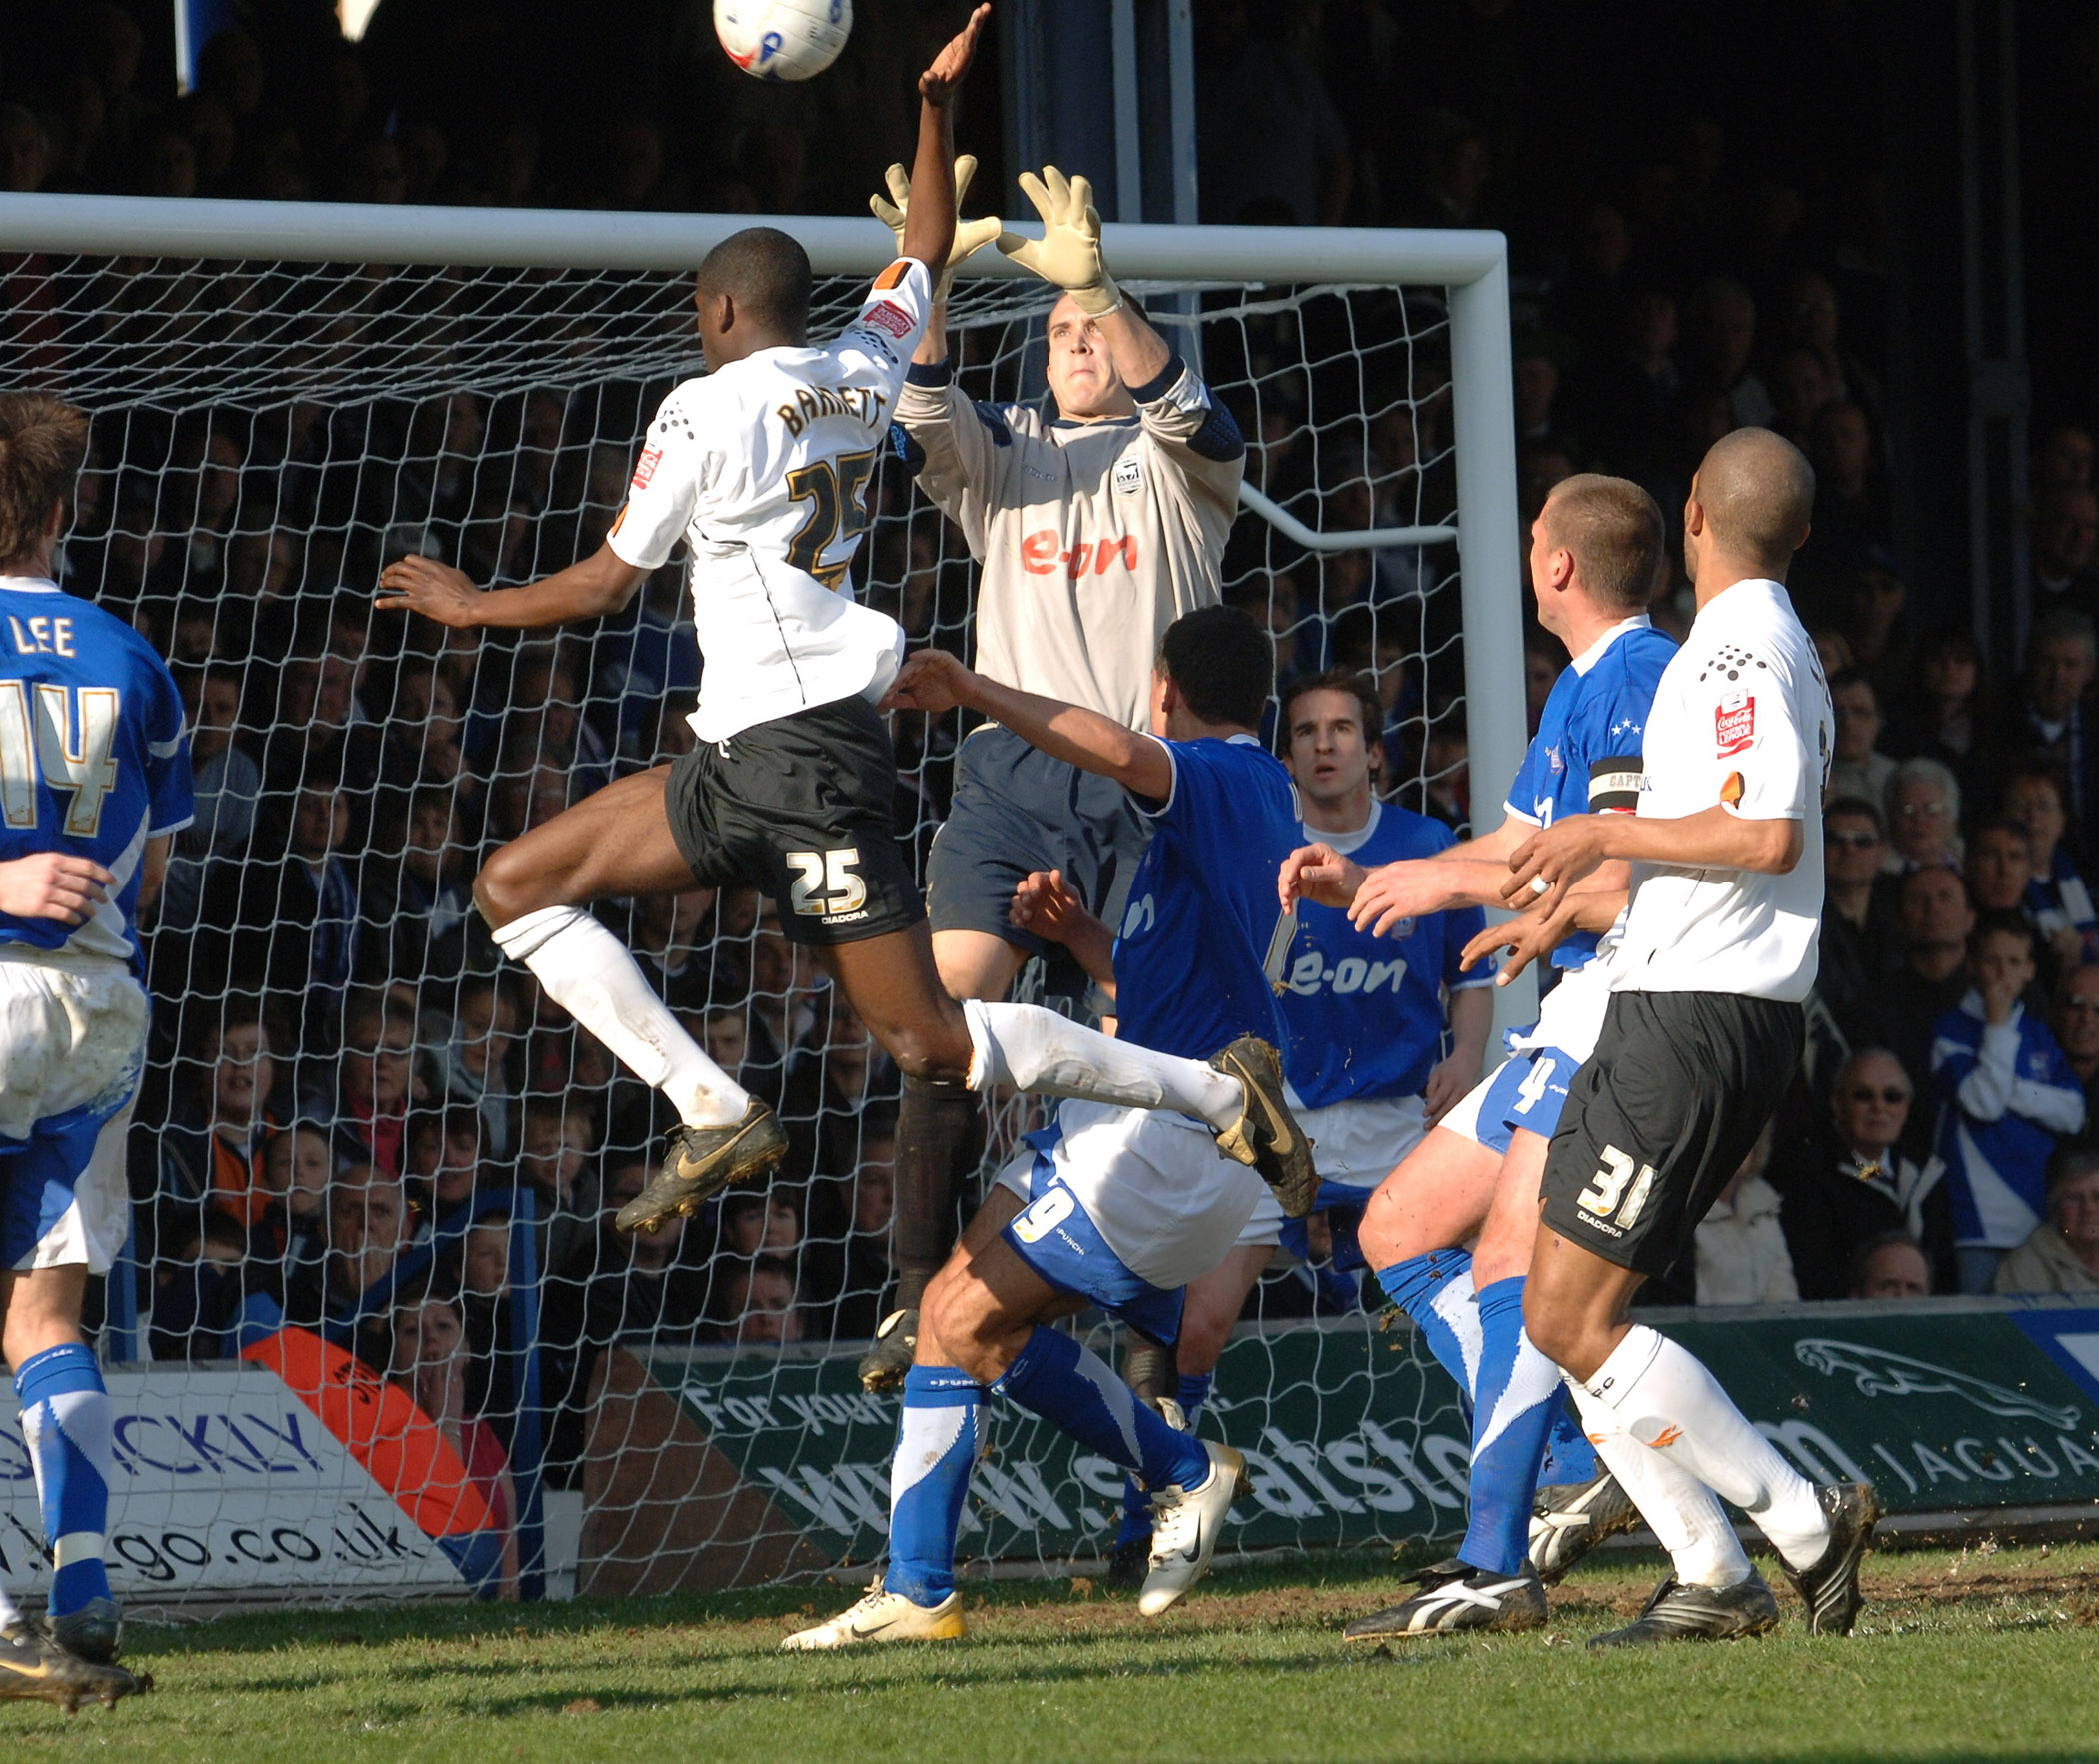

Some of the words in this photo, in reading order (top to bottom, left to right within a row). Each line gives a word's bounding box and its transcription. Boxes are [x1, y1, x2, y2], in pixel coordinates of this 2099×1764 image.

[8, 615, 75, 658] LEE
[0, 679, 120, 838] 14
[786, 848, 867, 915] 25
[821, 910, 869, 925] DIADORA
[1513, 1057, 1556, 1115] 4
[1012, 1187, 1075, 1243] 9
[1576, 1144, 1659, 1230] 31
[1576, 1209, 1624, 1238] DIADORA
[683, 1387, 780, 1430] For
[778, 1393, 894, 1436] your
[1872, 1432, 2099, 1494] JAGUA
